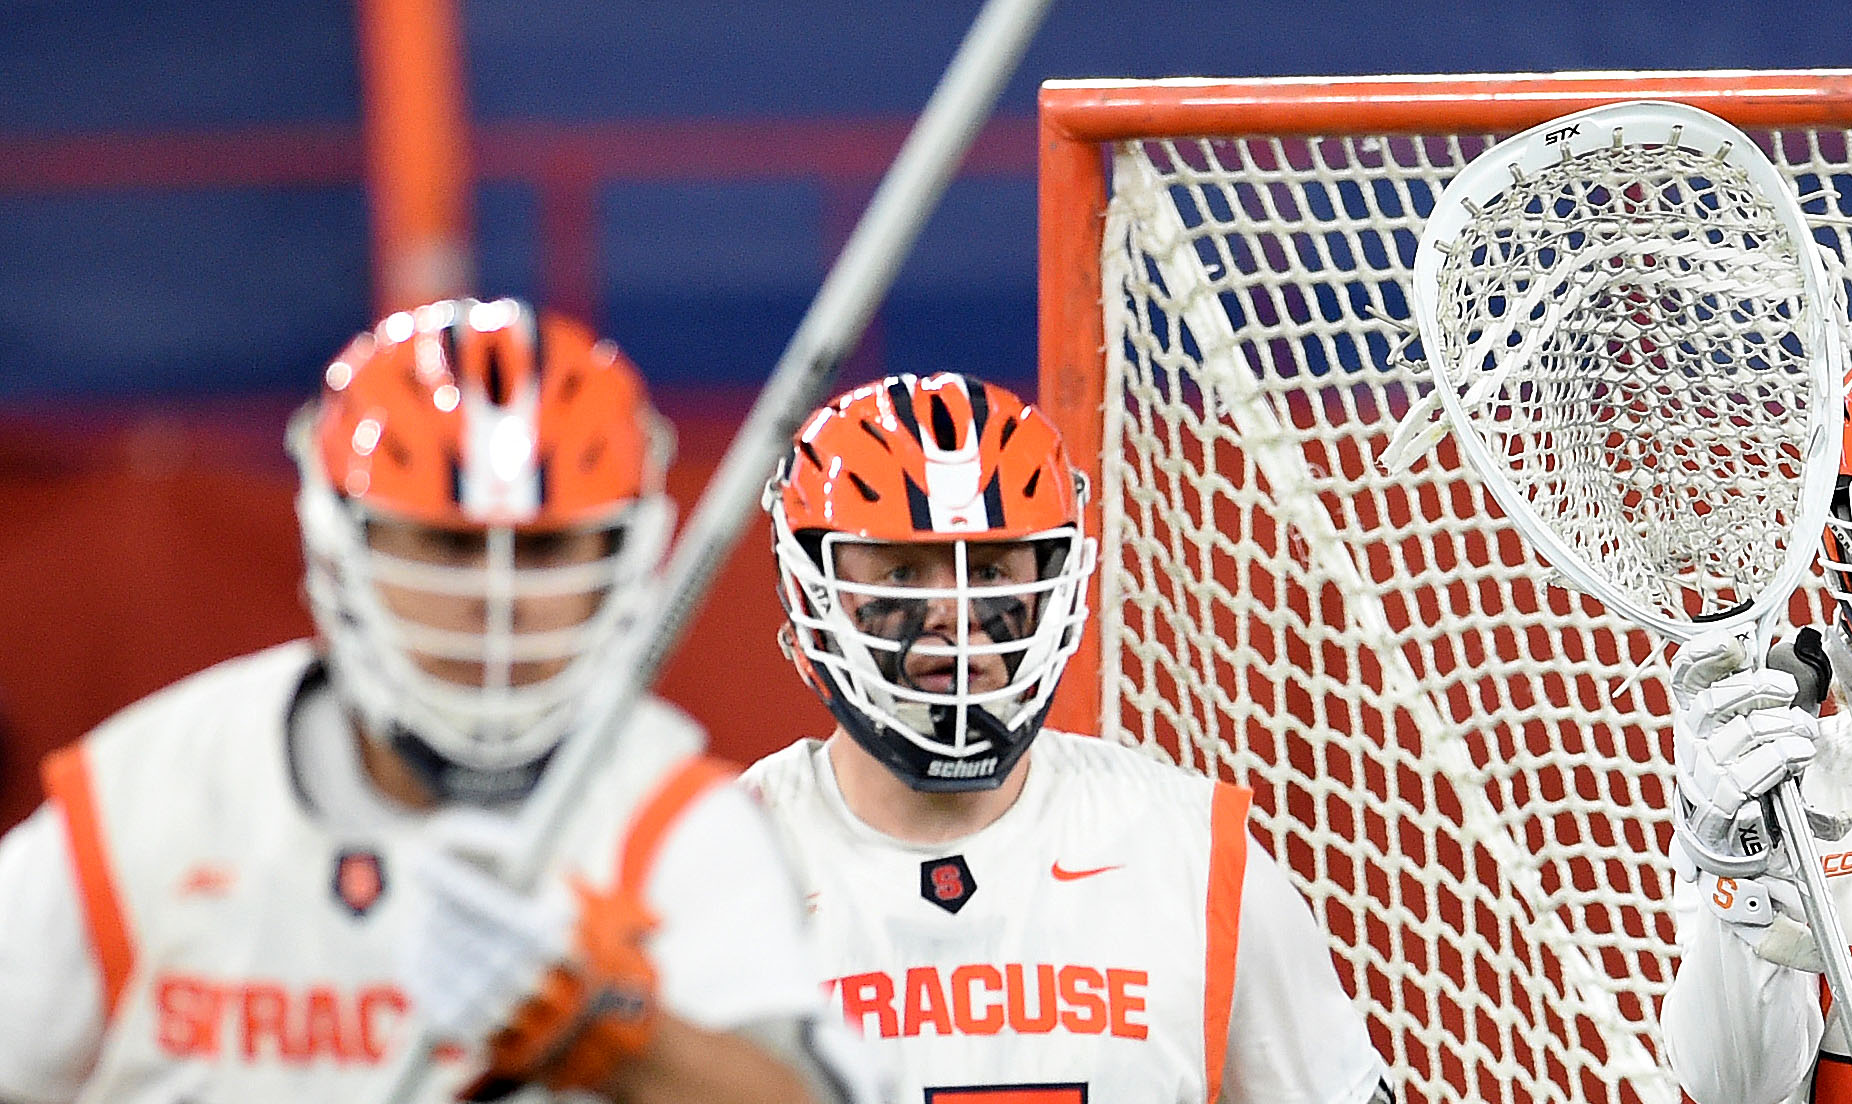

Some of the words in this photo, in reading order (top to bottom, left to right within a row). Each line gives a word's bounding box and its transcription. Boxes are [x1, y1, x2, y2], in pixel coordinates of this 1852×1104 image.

[1545, 123, 1581, 147] STX
[927, 756, 998, 778] schutt
[931, 863, 965, 901] S
[1712, 876, 1738, 909] S
[155, 972, 412, 1067] SYRAC
[820, 963, 1149, 1041] RACUSE
